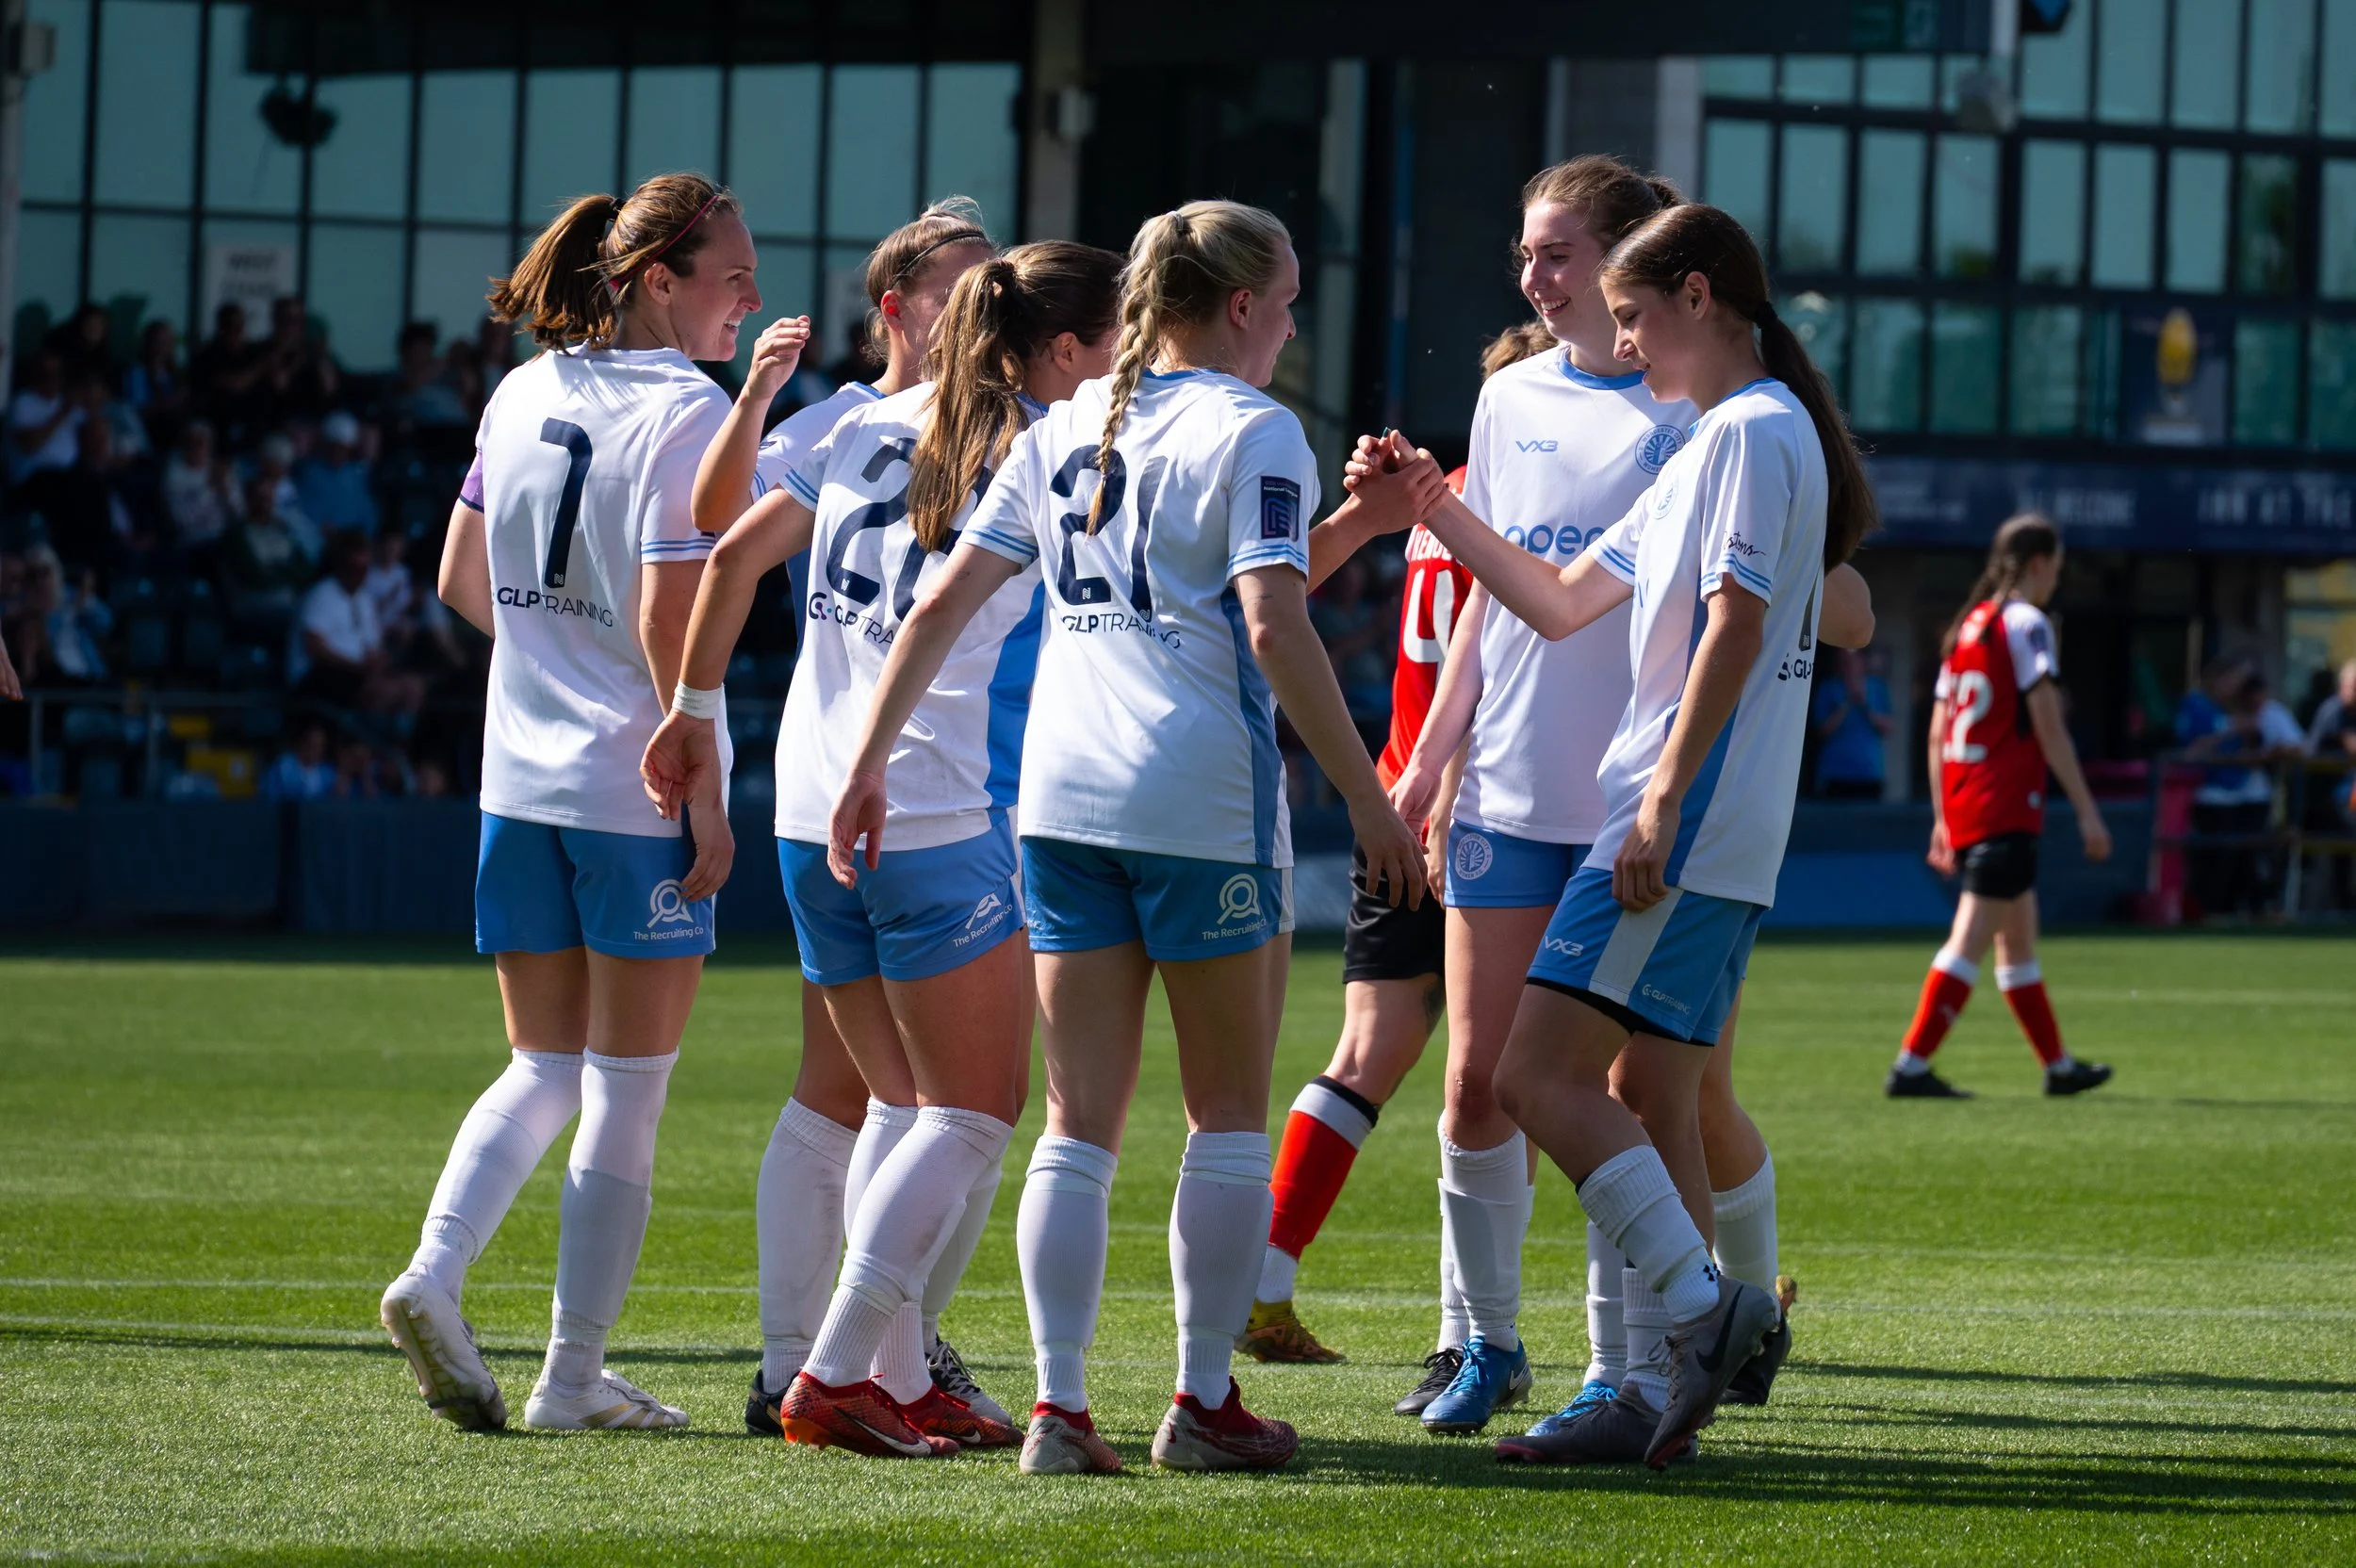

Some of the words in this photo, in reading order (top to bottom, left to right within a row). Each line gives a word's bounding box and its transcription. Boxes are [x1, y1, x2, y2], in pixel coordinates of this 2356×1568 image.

[1515, 440, 1560, 452] VX3
[540, 417, 593, 588] 7
[1049, 444, 1169, 623] 21
[633, 931, 648, 940] The
[650, 927, 694, 940] Recruiting
[695, 926, 704, 935] Co
[953, 935, 970, 948] The
[1003, 904, 1013, 914] Co
[1203, 930, 1219, 940] The
[1545, 936, 1584, 957] VX3
